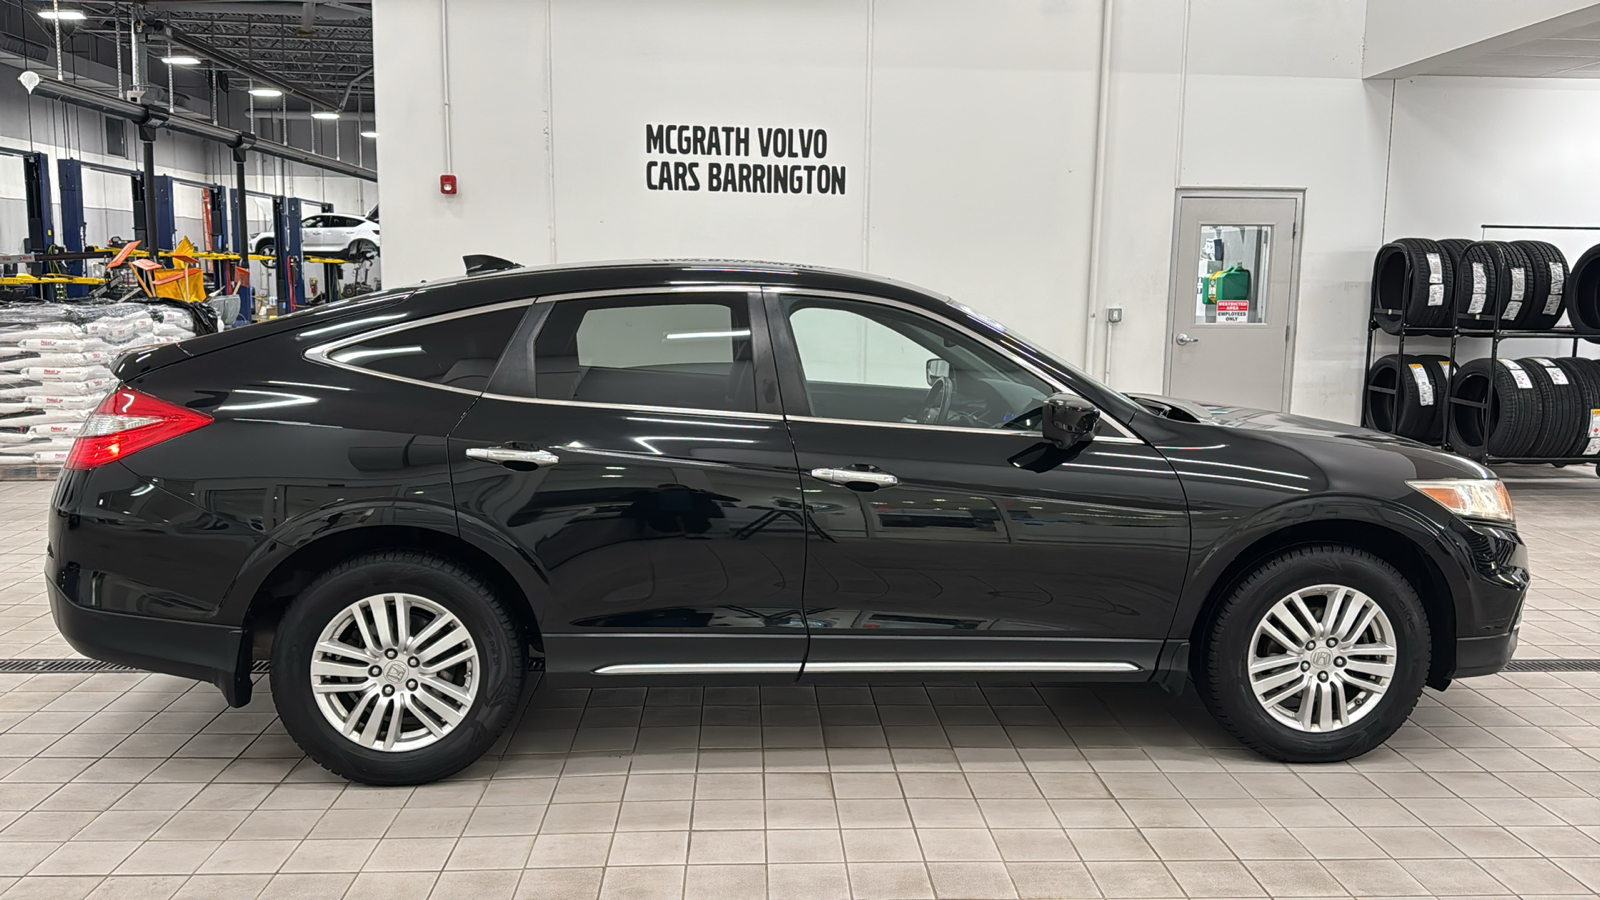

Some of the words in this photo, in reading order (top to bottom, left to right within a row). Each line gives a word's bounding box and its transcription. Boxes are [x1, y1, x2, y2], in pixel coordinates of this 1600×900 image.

[645, 123, 750, 157] MCGRATH
[757, 127, 828, 159] VOLVO
[645, 160, 701, 192] CARS
[707, 162, 846, 195] BARRINGTON
